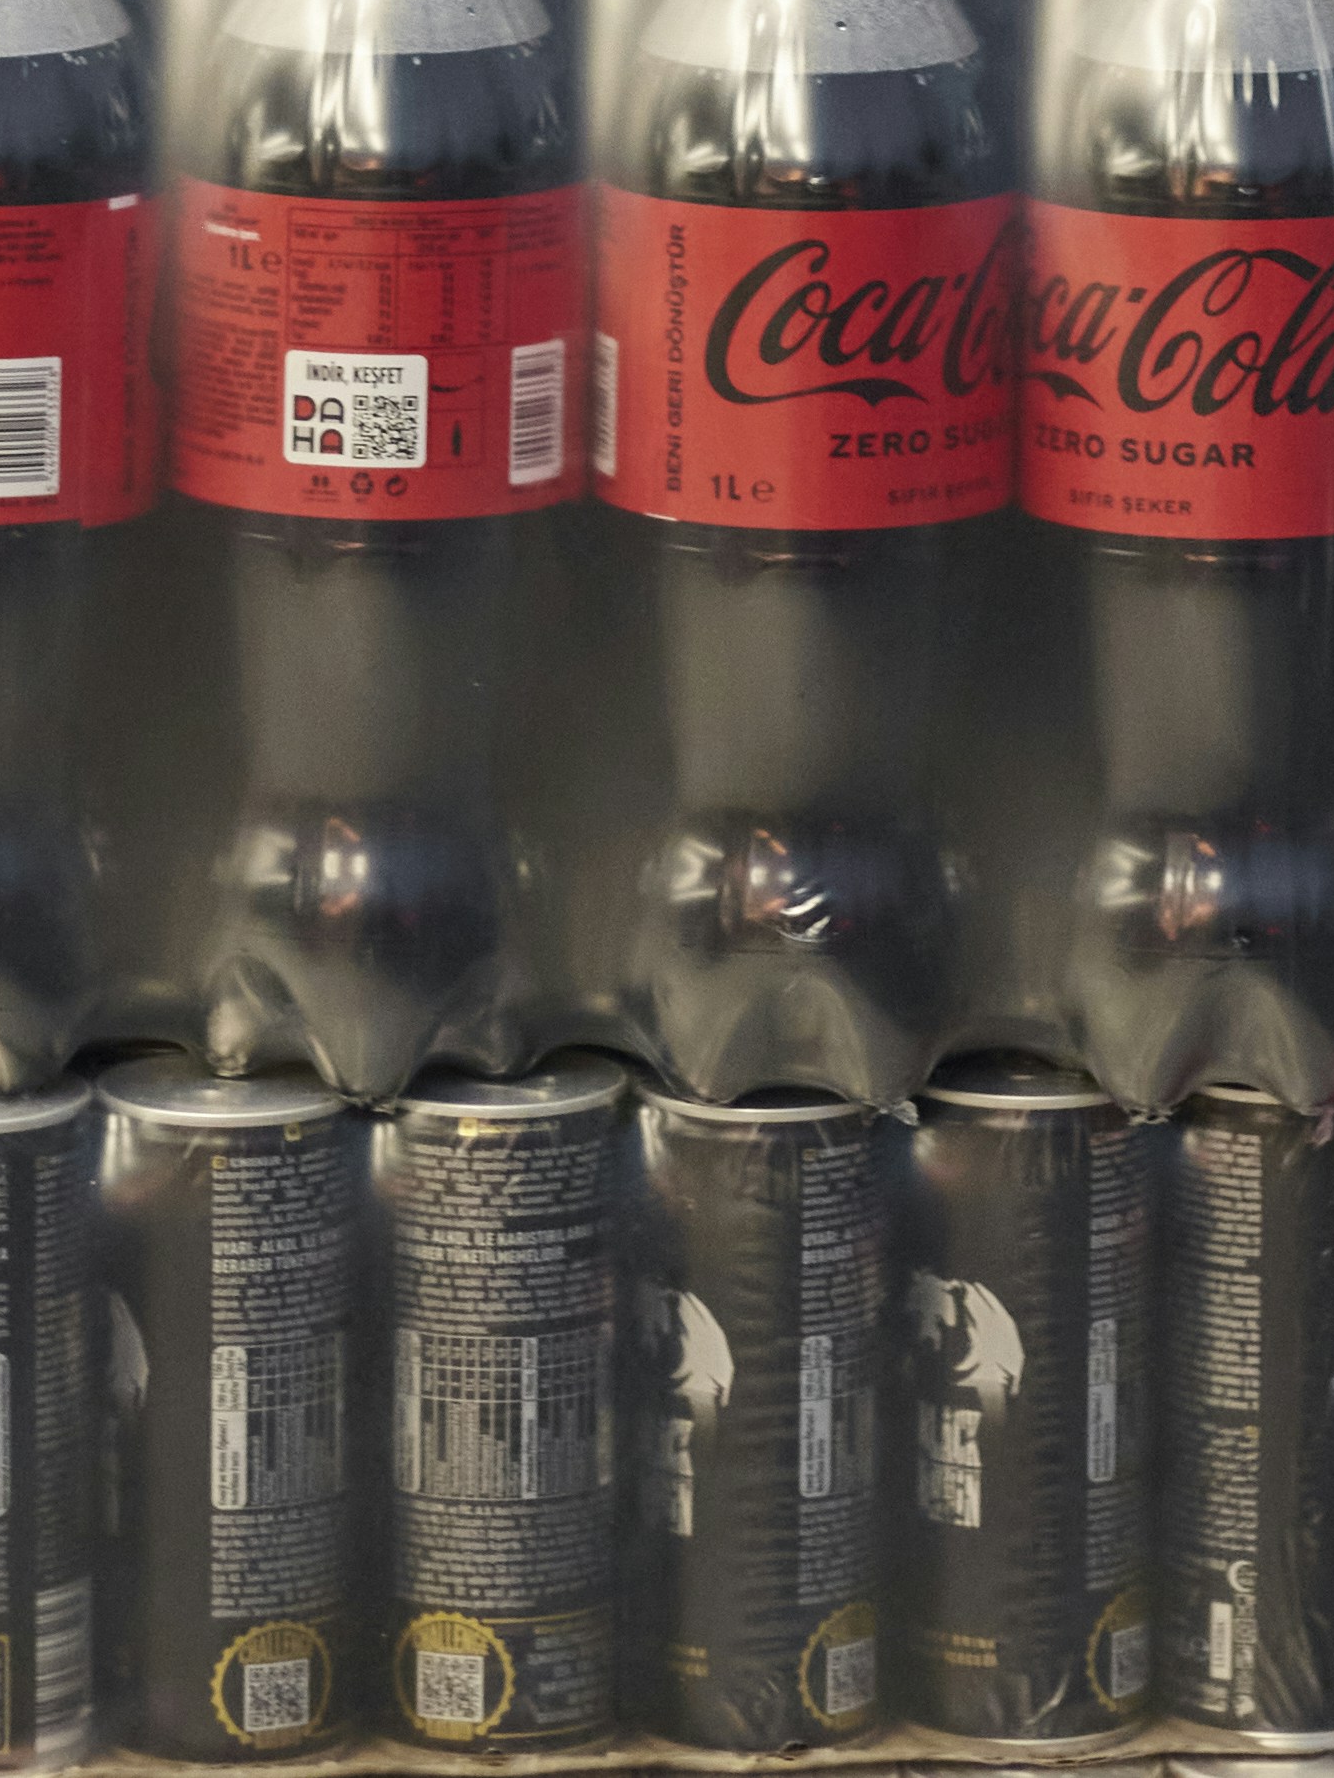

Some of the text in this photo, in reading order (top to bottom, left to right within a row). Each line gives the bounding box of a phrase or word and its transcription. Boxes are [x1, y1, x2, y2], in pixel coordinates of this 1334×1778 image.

[352, 364, 404, 393] KEŞFET
[828, 428, 931, 460] ZERO
[1034, 422, 1257, 470] ZERO SUGAR
[710, 473, 742, 503] 1L
[1121, 493, 1193, 517] ŞEKER
